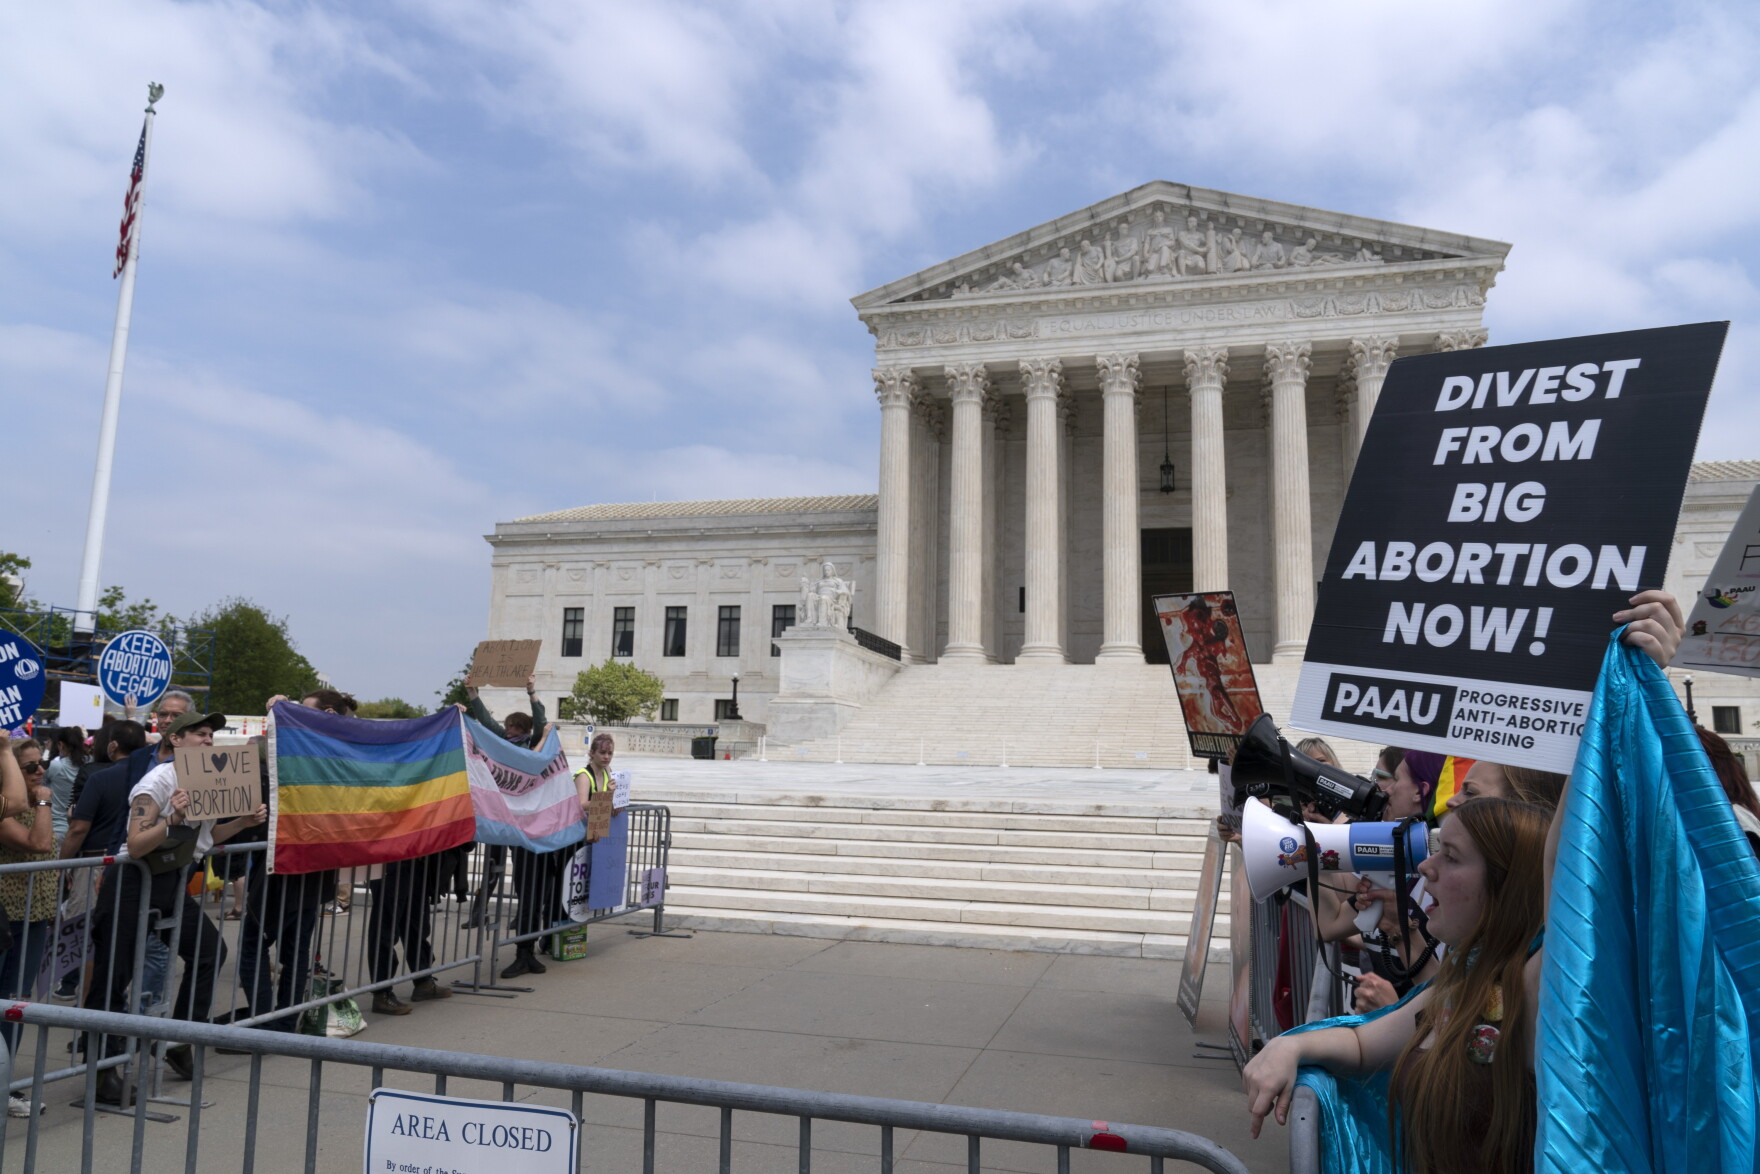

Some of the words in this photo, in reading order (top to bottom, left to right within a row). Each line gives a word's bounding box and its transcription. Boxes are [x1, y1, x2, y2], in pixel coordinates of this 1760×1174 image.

[1050, 319, 1105, 333] EQUAL
[1108, 312, 1173, 330] JUSTICE
[1180, 308, 1237, 324] UNDER
[1243, 304, 1277, 320] LAW
[1434, 358, 1642, 412] DIVEST
[1432, 419, 1602, 466] FROM
[1447, 481, 1547, 523] BIG
[1341, 541, 1648, 592] ABORTION
[1730, 586, 1756, 594] PAAU
[1382, 601, 1554, 656] NOW!
[120, 634, 162, 656] KEEP
[103, 649, 169, 681] ABORTION
[472, 664, 531, 679] HEALTHCARE
[499, 654, 514, 664] IS
[107, 671, 159, 698] LEGAL
[1333, 682, 1441, 726] PAAU
[1459, 690, 1584, 717] PROGRESSIVE
[1451, 725, 1535, 749] UPRISING
[184, 754, 190, 776] I
[215, 777, 227, 787] MY
[1319, 778, 1335, 790] PAAU
[186, 785, 252, 817] ABORTION
[1357, 846, 1378, 854] PAAU
[391, 1113, 451, 1142] AREA
[462, 1122, 552, 1152] CLOSED
[386, 1159, 397, 1172] By
[399, 1163, 420, 1174] order
[423, 1166, 432, 1174] of
